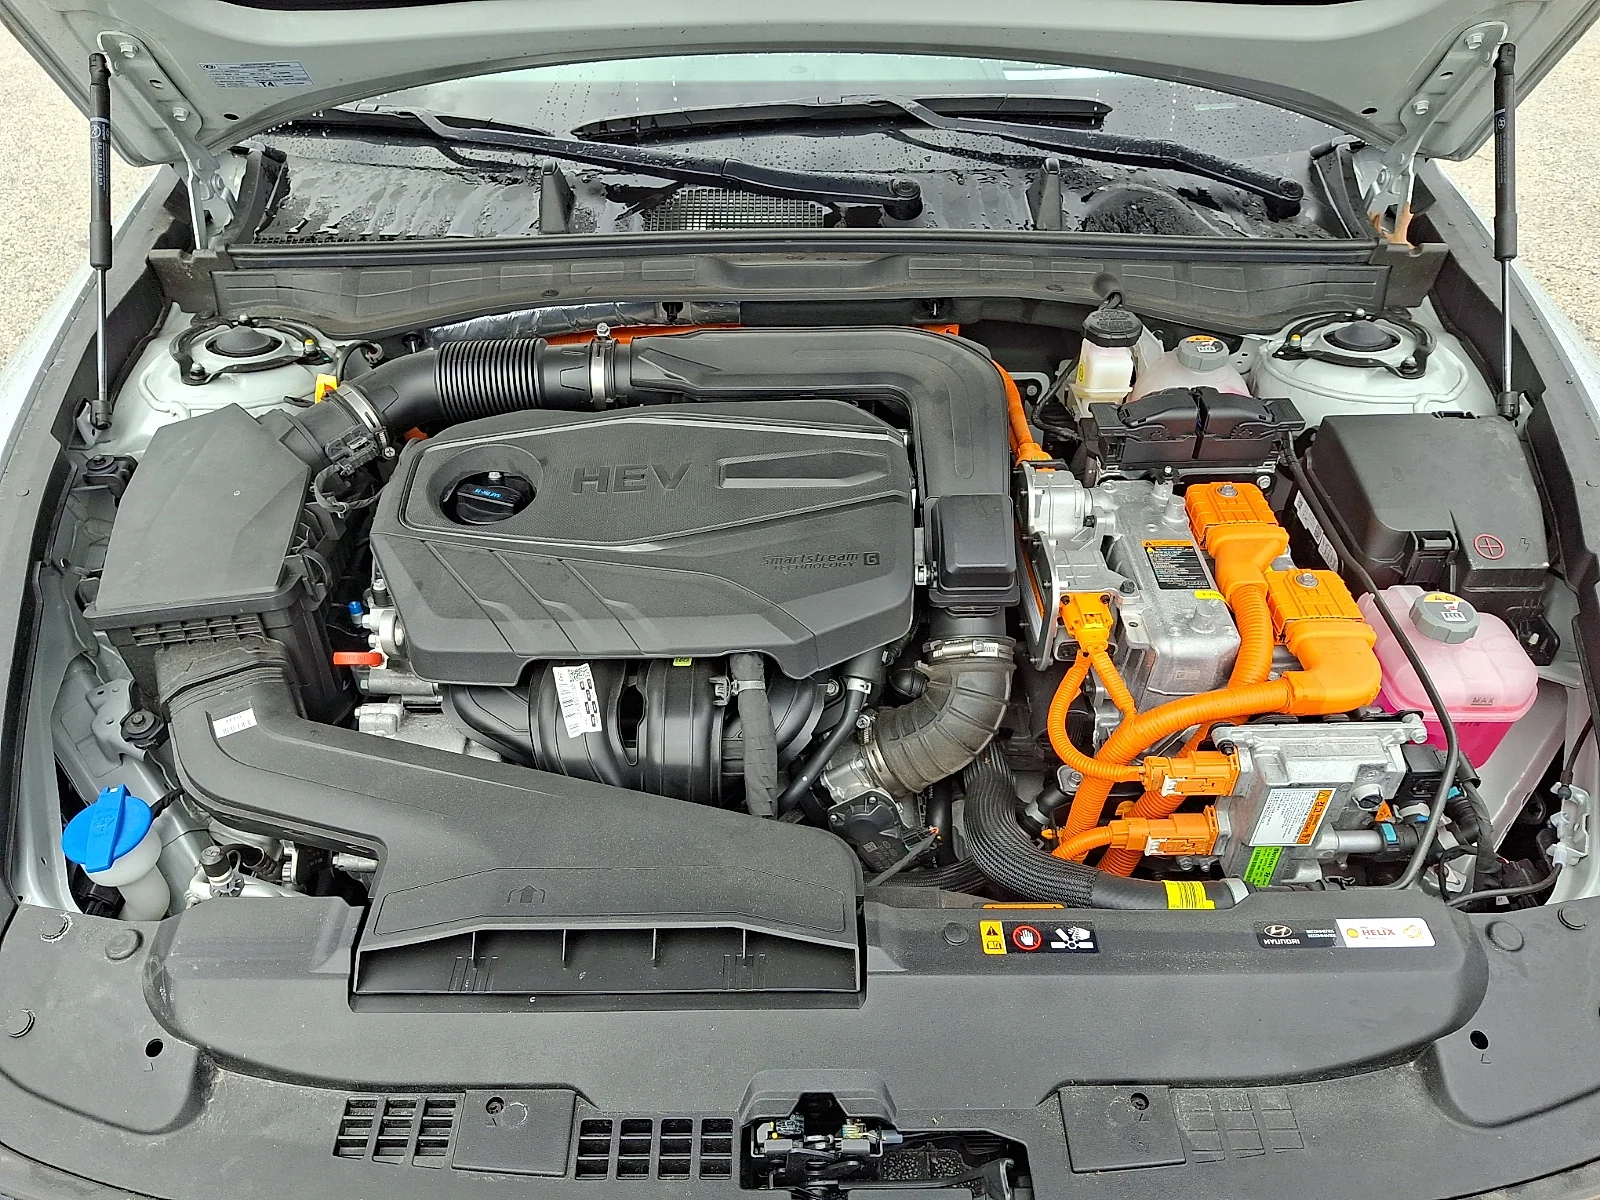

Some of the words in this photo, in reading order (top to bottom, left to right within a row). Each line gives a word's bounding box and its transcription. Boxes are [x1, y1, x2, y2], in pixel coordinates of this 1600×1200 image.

[571, 461, 693, 495] HEV
[761, 551, 859, 566] Smartstream
[1361, 927, 1397, 936] HELIX
